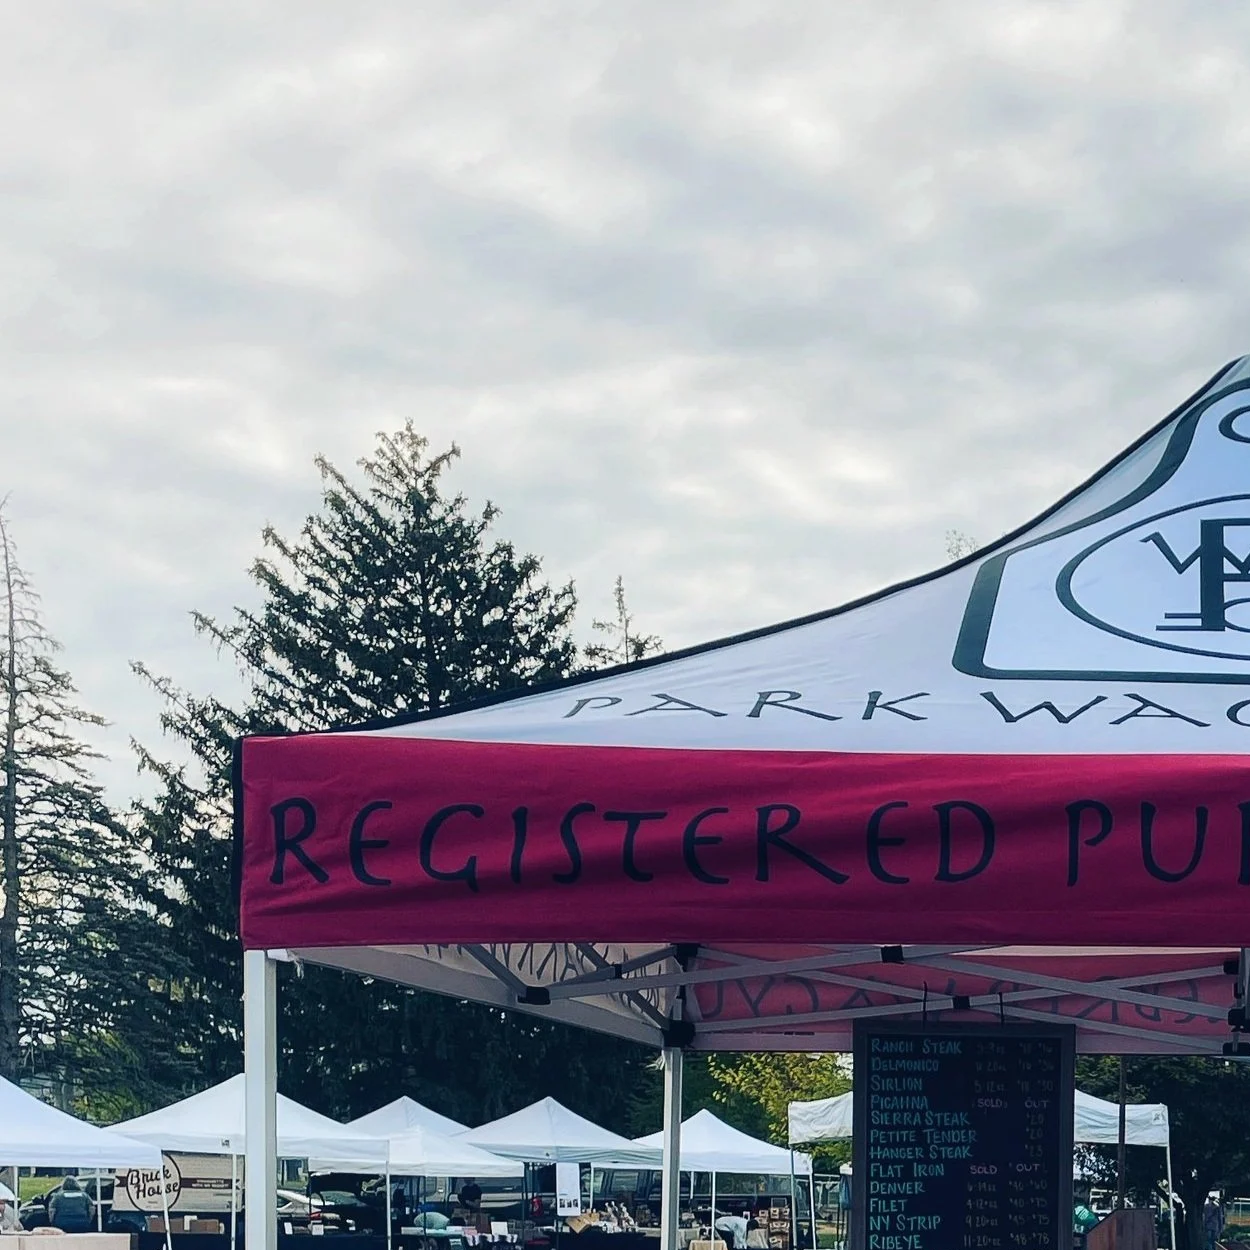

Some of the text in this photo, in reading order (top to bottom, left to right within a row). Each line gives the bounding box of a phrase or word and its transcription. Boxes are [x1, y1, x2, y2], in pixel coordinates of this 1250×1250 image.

[563, 689, 932, 723] PARK
[268, 797, 996, 893] REGISTERED
[871, 1110, 970, 1126] SIERRA STEAK
[870, 1128, 978, 1144] PETITE TENDER
[869, 1144, 974, 1159] HANGER STEAK
[870, 1162, 944, 1178] FLAT IRON
[870, 1181, 926, 1194] DENVER
[870, 1198, 908, 1212] FILET
[870, 1214, 941, 1231] NY STRIP
[870, 1234, 923, 1250] RIBEYE
